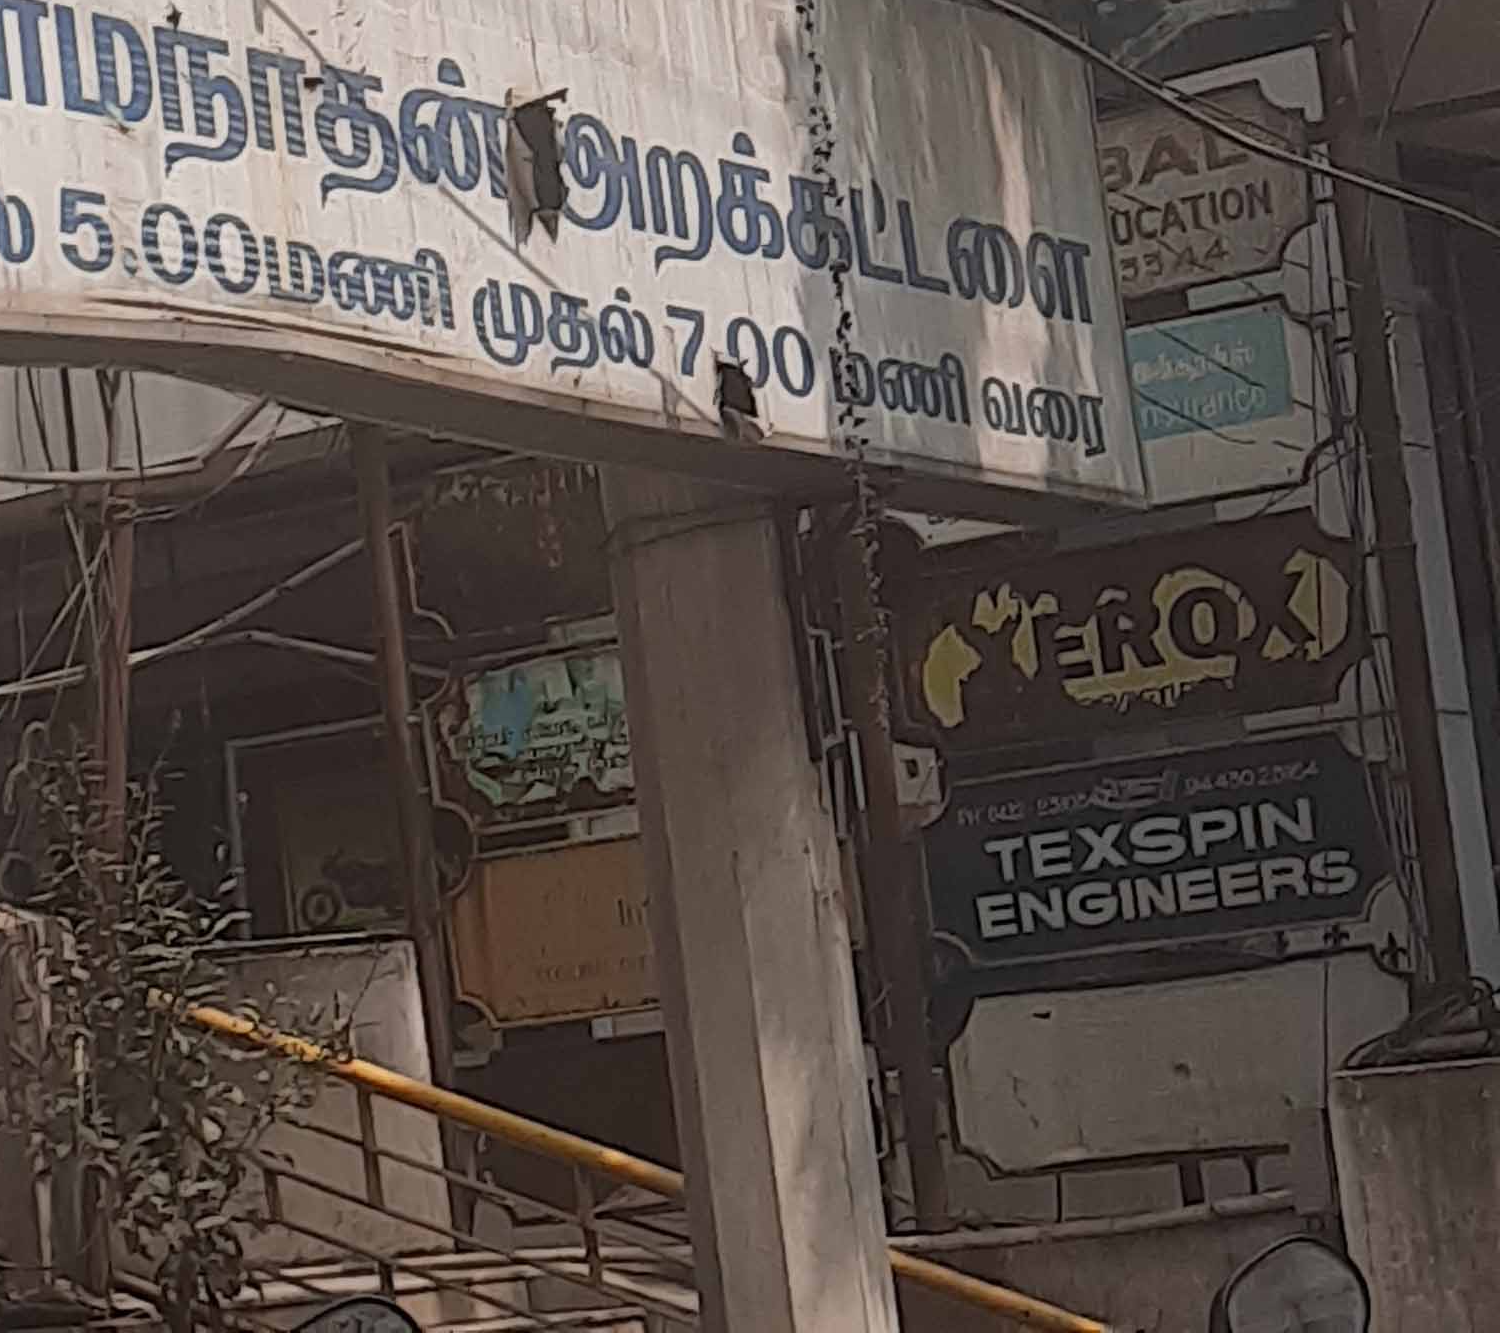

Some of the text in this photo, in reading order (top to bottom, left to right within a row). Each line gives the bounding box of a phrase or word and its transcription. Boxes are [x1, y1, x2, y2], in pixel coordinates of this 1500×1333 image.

[473, 276, 655, 376] முதல்
[983, 375, 1107, 457] வரை
[983, 797, 1317, 883] TEXSPIN
[973, 850, 1359, 940] ENGINEERS
